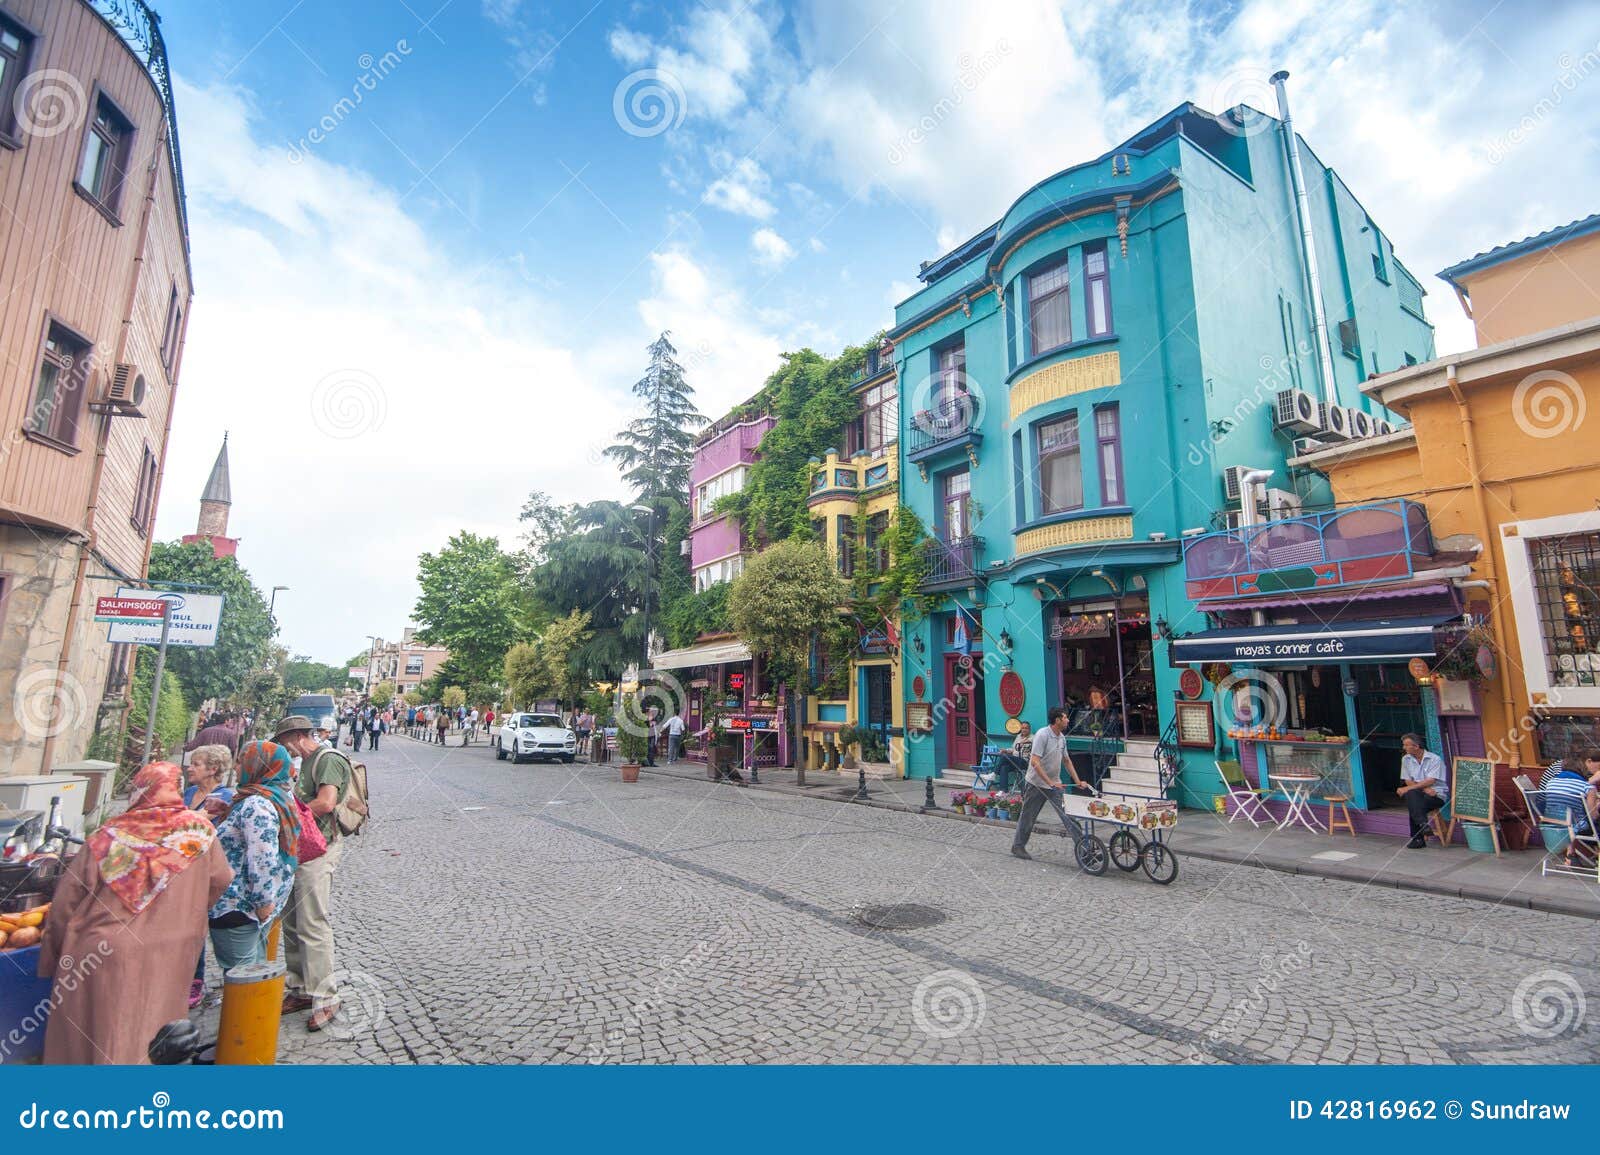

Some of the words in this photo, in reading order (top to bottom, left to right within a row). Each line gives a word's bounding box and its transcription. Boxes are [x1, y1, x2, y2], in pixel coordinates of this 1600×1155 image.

[1235, 645, 1271, 657] maya's
[1275, 643, 1312, 655] corner
[1316, 639, 1344, 653] cafe
